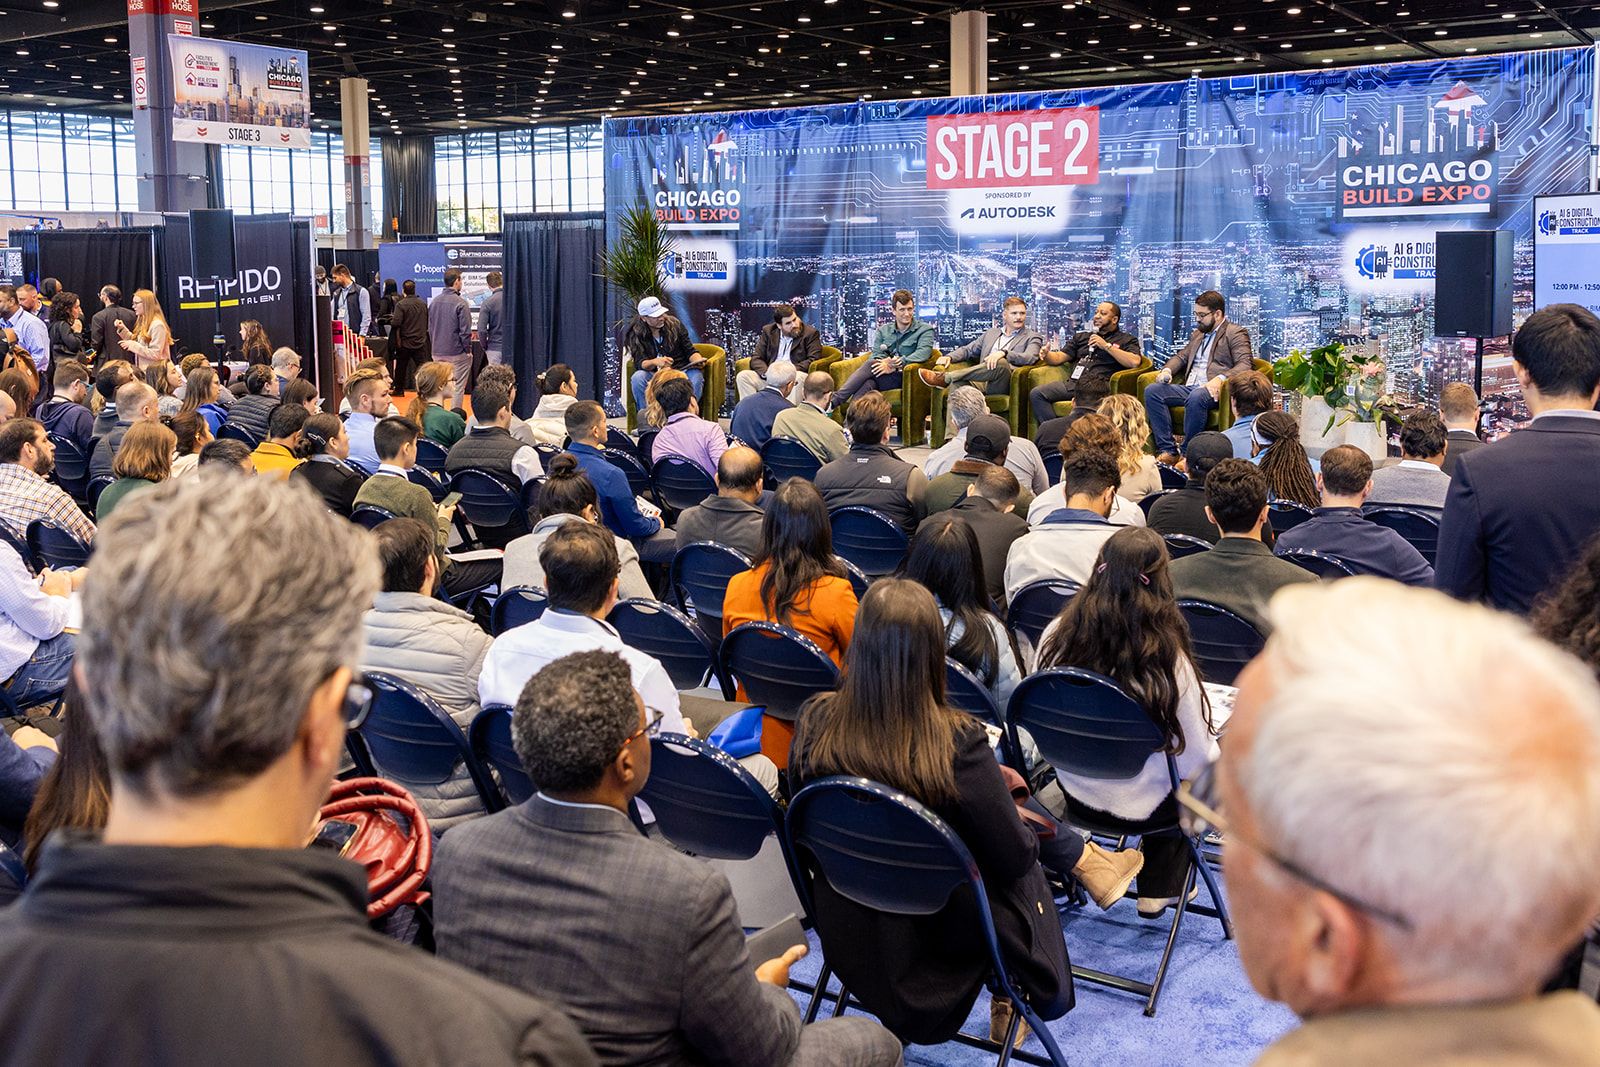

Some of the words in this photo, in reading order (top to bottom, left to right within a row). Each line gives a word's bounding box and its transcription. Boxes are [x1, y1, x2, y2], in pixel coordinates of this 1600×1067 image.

[129, 2, 144, 11] HOSE
[171, 2, 193, 12] HOSE
[268, 73, 302, 83] CHICAGO
[228, 128, 254, 142] STAGE
[255, 130, 261, 142] 3
[935, 121, 1054, 181] STAGE
[1063, 119, 1090, 176] 2
[1342, 159, 1493, 187] CHICAGO
[655, 189, 742, 208] CHICAGO
[984, 191, 1023, 199] SPONSORED
[1343, 187, 1414, 205] BUILD
[1422, 184, 1491, 203] EXPO
[656, 209, 697, 222] BUILD
[699, 208, 741, 221] EXPO
[978, 205, 1057, 219] AUTODESK
[1559, 208, 1566, 218] AI
[1566, 208, 1571, 218] &
[1571, 207, 1593, 218] DIGITAL
[1571, 227, 1590, 235] TRACK
[1394, 242, 1404, 255] AI
[1406, 242, 1413, 255] &
[685, 251, 691, 261] AI
[691, 251, 697, 261] &
[696, 251, 719, 262] DIGITAL
[685, 261, 728, 272] CONSTRUCTION
